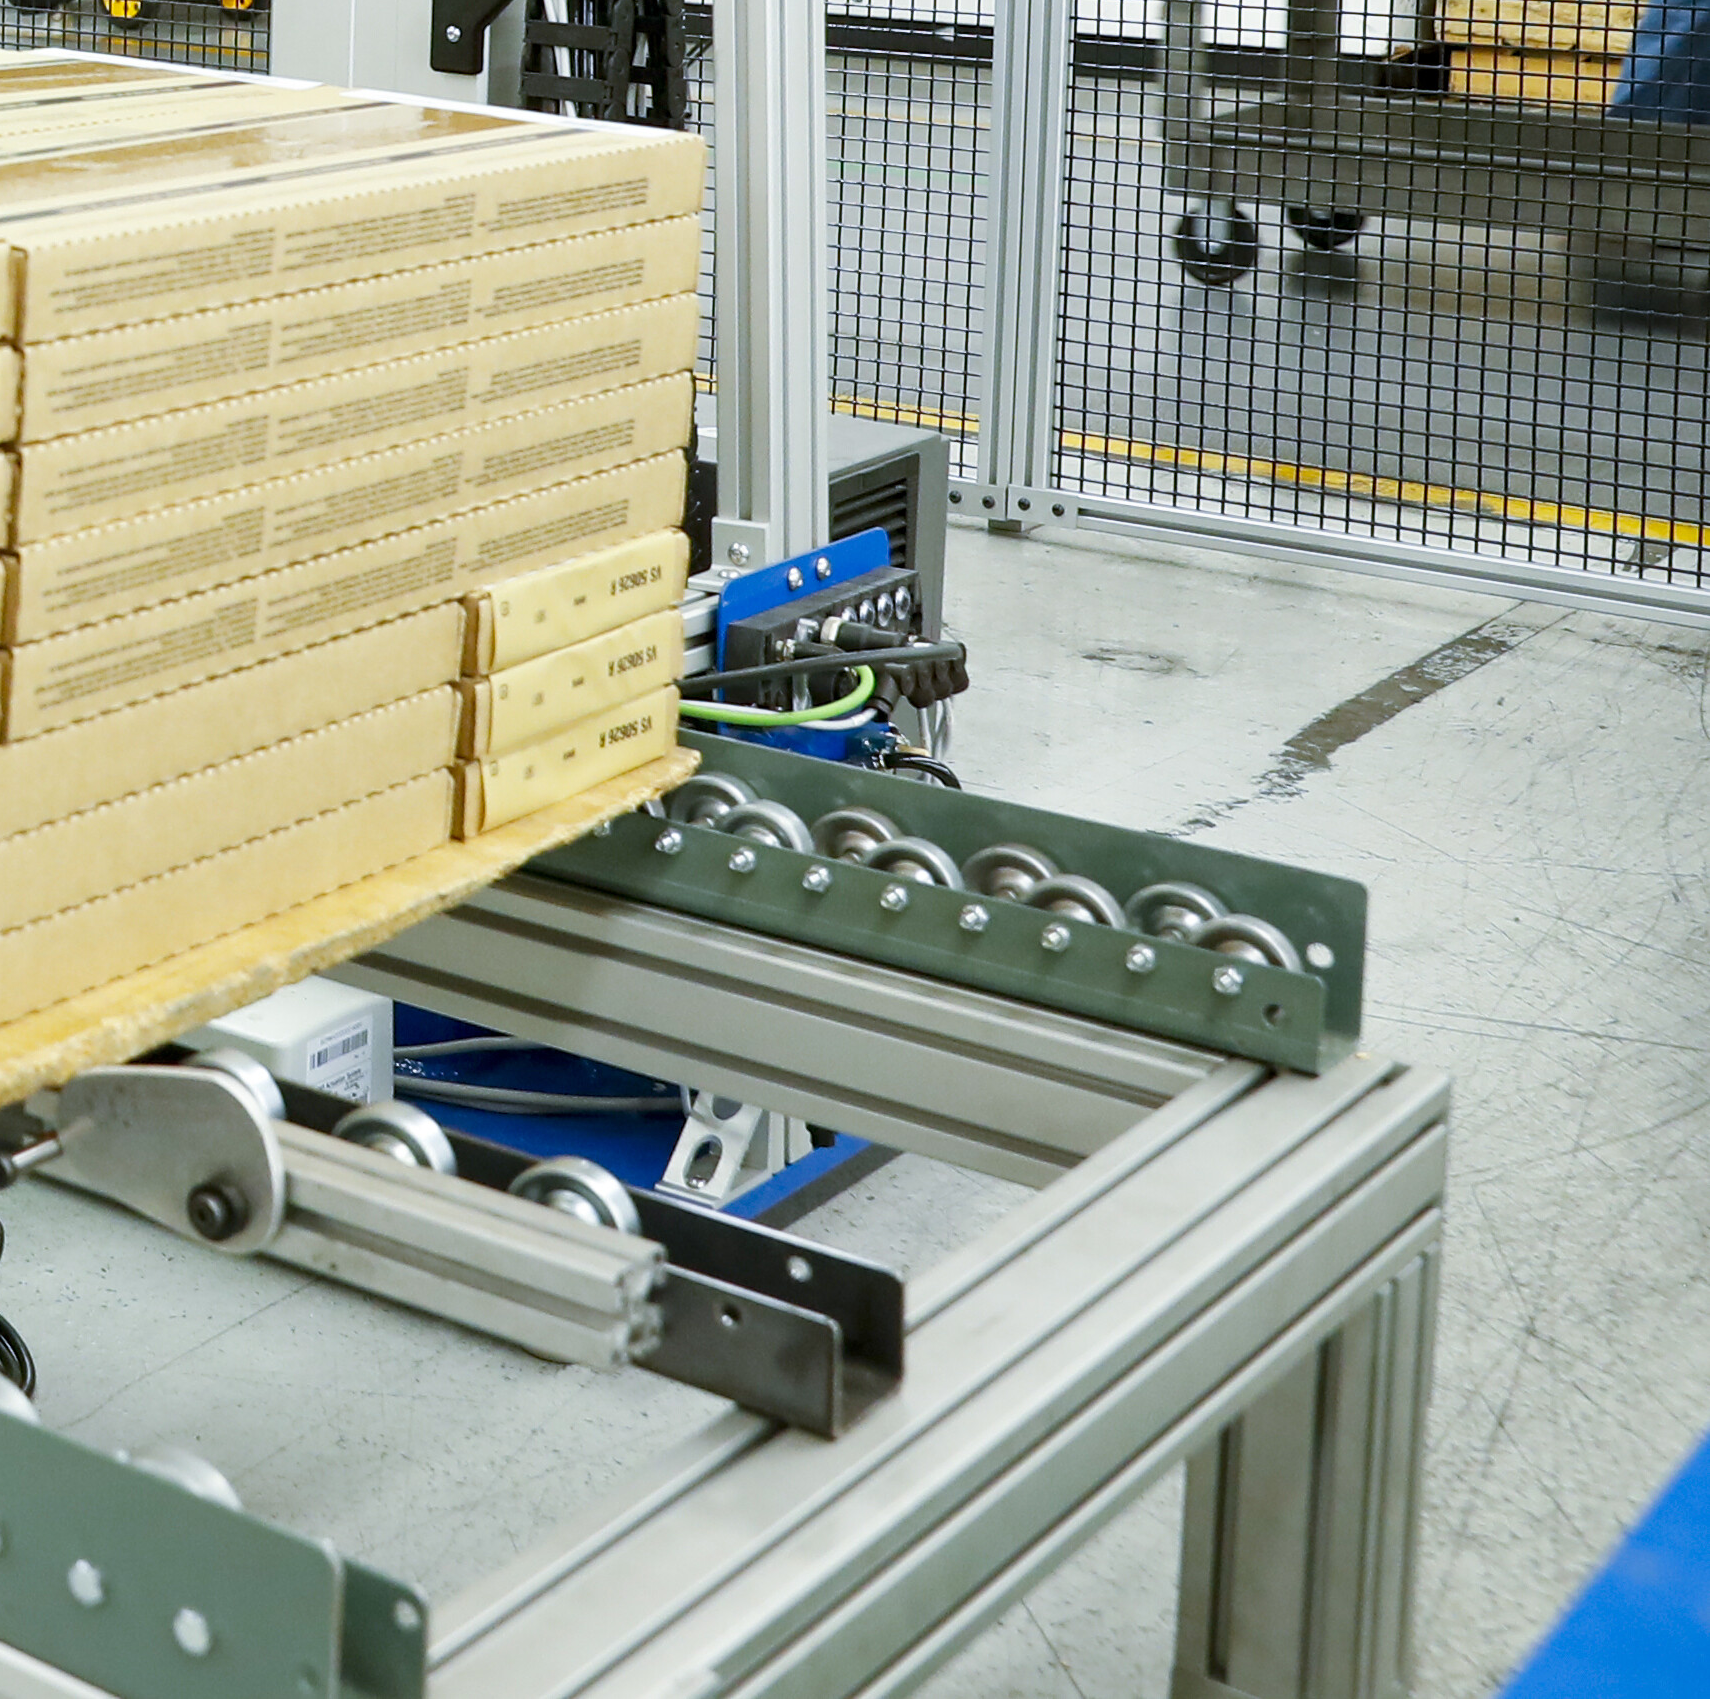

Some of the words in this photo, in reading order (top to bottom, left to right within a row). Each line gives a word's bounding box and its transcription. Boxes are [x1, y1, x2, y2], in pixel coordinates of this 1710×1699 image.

[649, 565, 662, 583] VS
[645, 644, 658, 663] VS
[640, 715, 653, 734] VS
